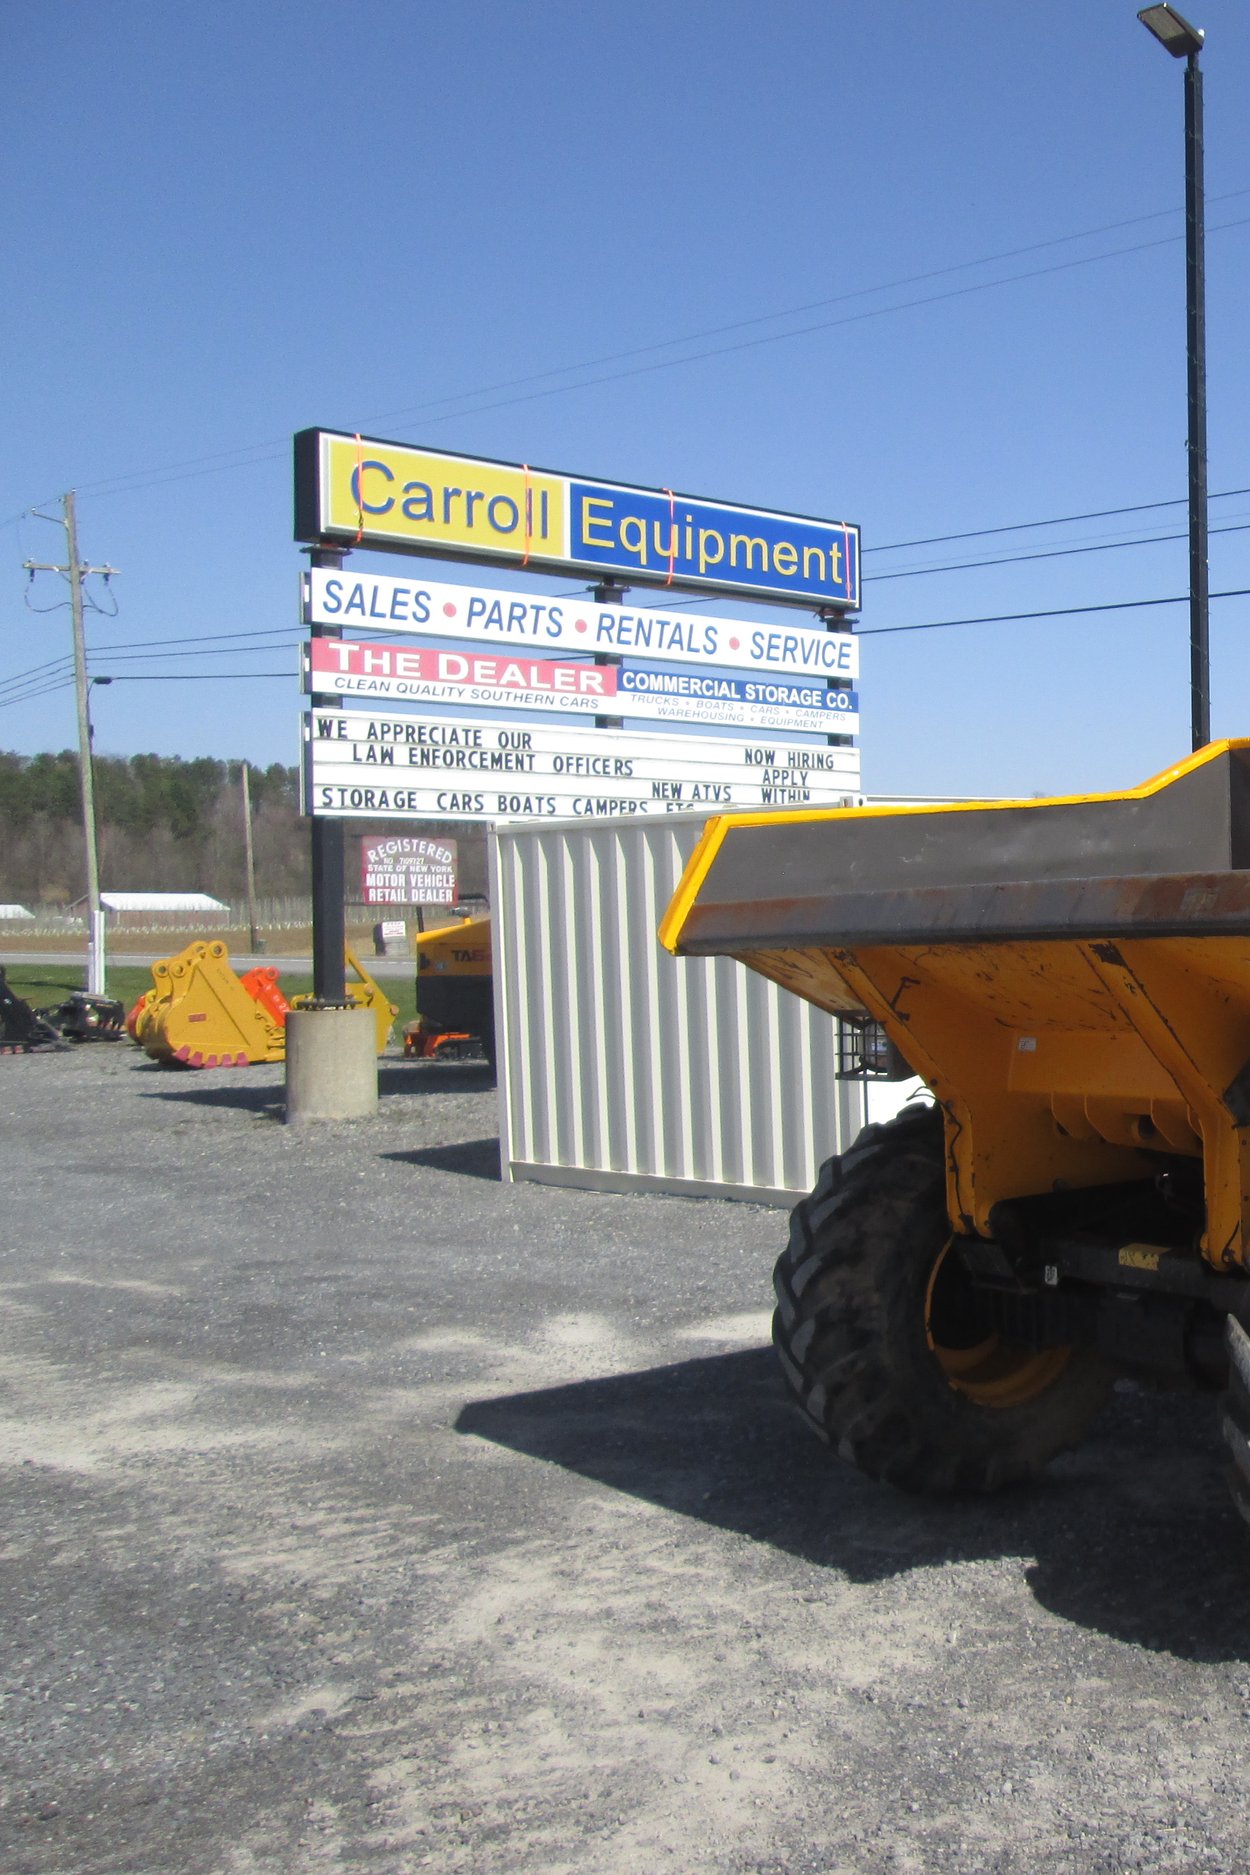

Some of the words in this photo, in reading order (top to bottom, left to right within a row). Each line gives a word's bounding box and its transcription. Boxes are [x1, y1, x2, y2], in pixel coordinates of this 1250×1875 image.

[351, 460, 548, 539] Carroll
[581, 496, 843, 584] Equipment
[322, 579, 432, 623] SALES
[466, 596, 564, 638] PARTS
[596, 612, 718, 655] RENTALS
[750, 631, 852, 670] SERVICE
[328, 642, 422, 678] THE
[438, 653, 604, 694] DEALER
[334, 677, 391, 692] CLEAN
[396, 682, 467, 699] QUALITY
[470, 688, 555, 706] SOUTHERN
[559, 696, 599, 709] CARS
[622, 671, 741, 699] COMMERCIAL
[745, 683, 823, 707] STORAGE
[826, 692, 853, 710] CO.
[631, 693, 680, 706] TRUCKS
[696, 700, 734, 711] BOATS
[750, 704, 780, 715] CARS
[795, 708, 846, 721] CAMPERS
[657, 707, 744, 722] WAREHOUSING
[760, 716, 824, 729] EQUIPMENT
[318, 719, 348, 739] WE
[367, 722, 483, 747] APPRECIATE
[498, 731, 532, 750] OUR
[353, 743, 394, 764] LAW
[409, 747, 536, 771] ENFORCEMENT
[553, 755, 634, 777] OFFICERS
[745, 748, 776, 766] NOW
[788, 751, 834, 770] HIRING
[762, 769, 808, 787] APPLY
[322, 787, 417, 810] STORAGE
[437, 792, 484, 812] CARS
[498, 795, 556, 815] BOATS
[572, 798, 649, 815] CAMPERS
[652, 782, 682, 800] NEW
[692, 784, 732, 802] ATVS
[761, 787, 811, 804] WITHIN
[367, 839, 452, 863] REGISTERED
[366, 873, 406, 887] MOTOR
[410, 874, 455, 887] VEHICLE
[367, 864, 394, 872] STATE
[409, 865, 428, 873] NEW
[430, 865, 453, 873] YORK
[368, 888, 408, 902] RETAIL
[411, 889, 453, 902] DEALER
